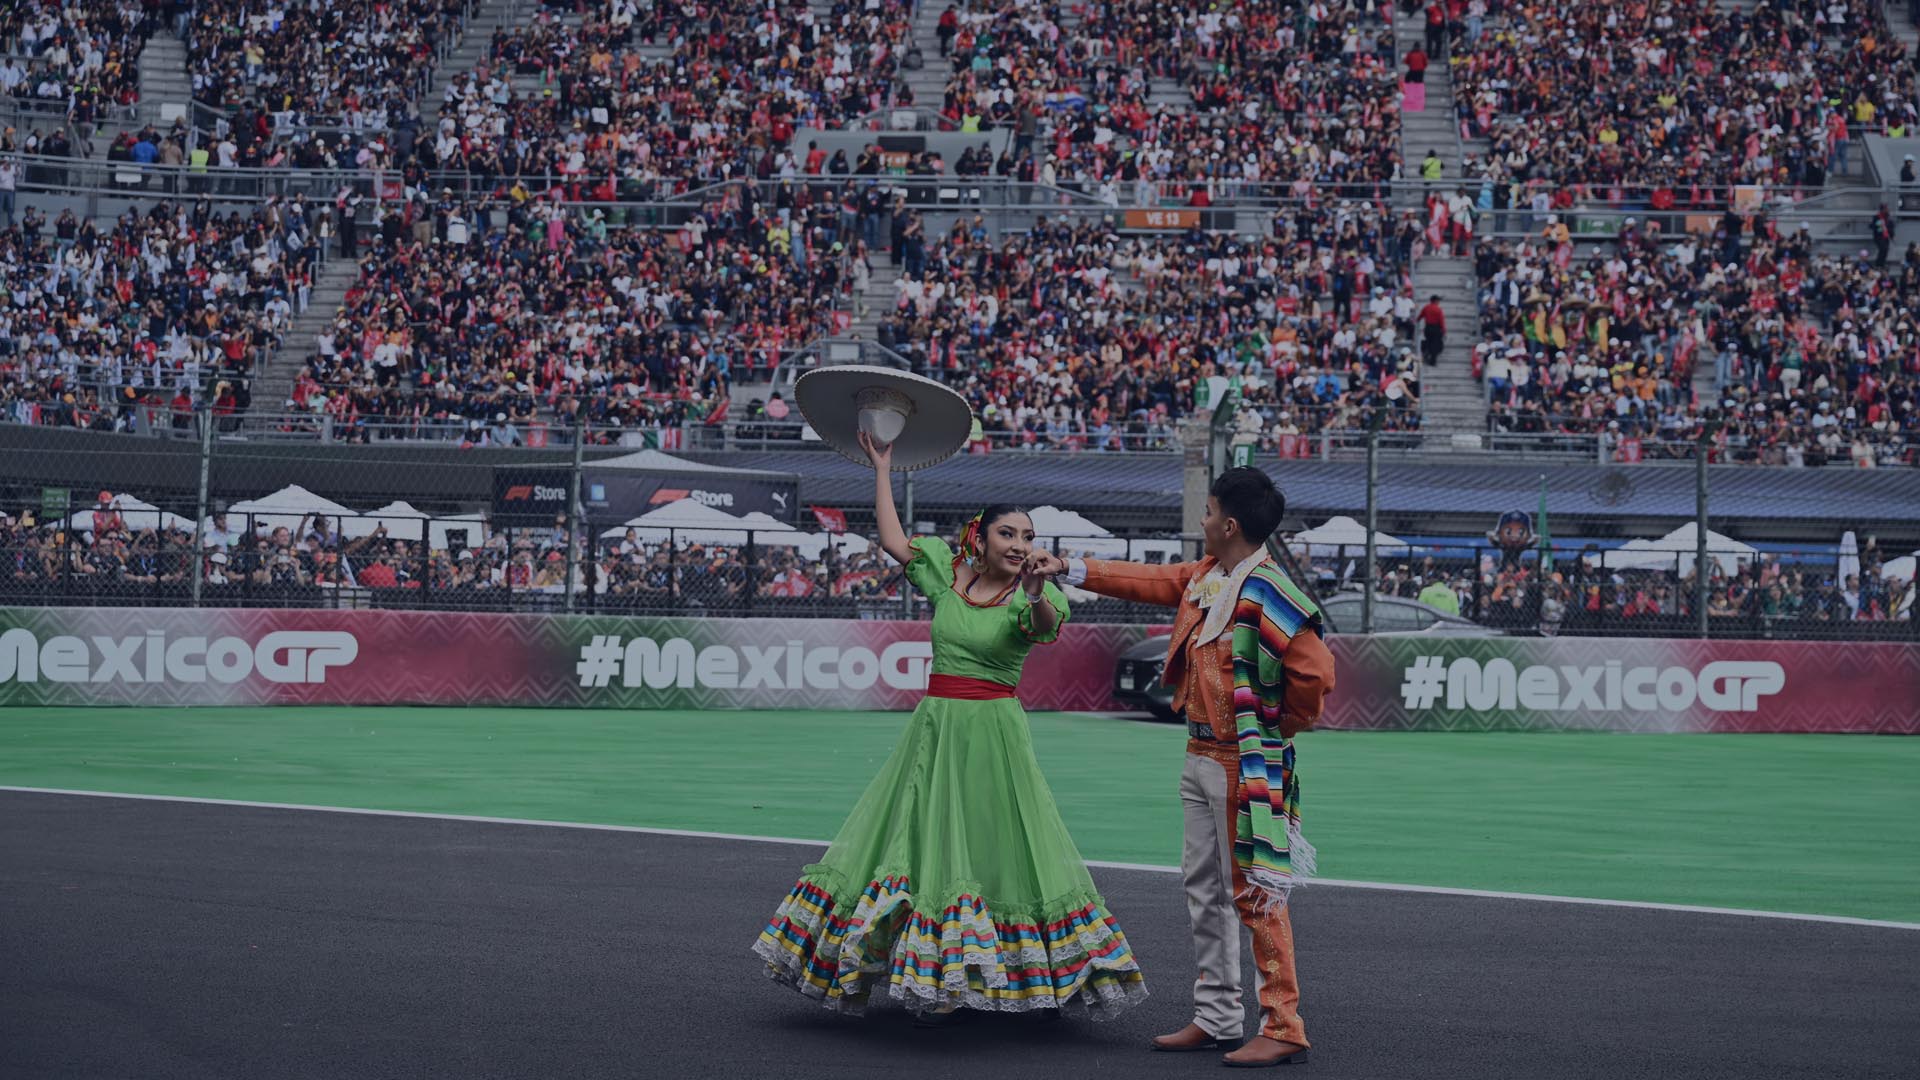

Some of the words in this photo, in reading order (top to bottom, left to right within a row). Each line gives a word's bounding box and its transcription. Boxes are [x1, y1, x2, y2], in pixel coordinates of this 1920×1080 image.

[1146, 211, 1163, 225] VE
[1166, 211, 1180, 225] 13
[534, 485, 566, 501] Store
[691, 489, 734, 507] Store
[576, 635, 933, 690] #MexicoG
[1401, 656, 1785, 712] #MexicoGP
